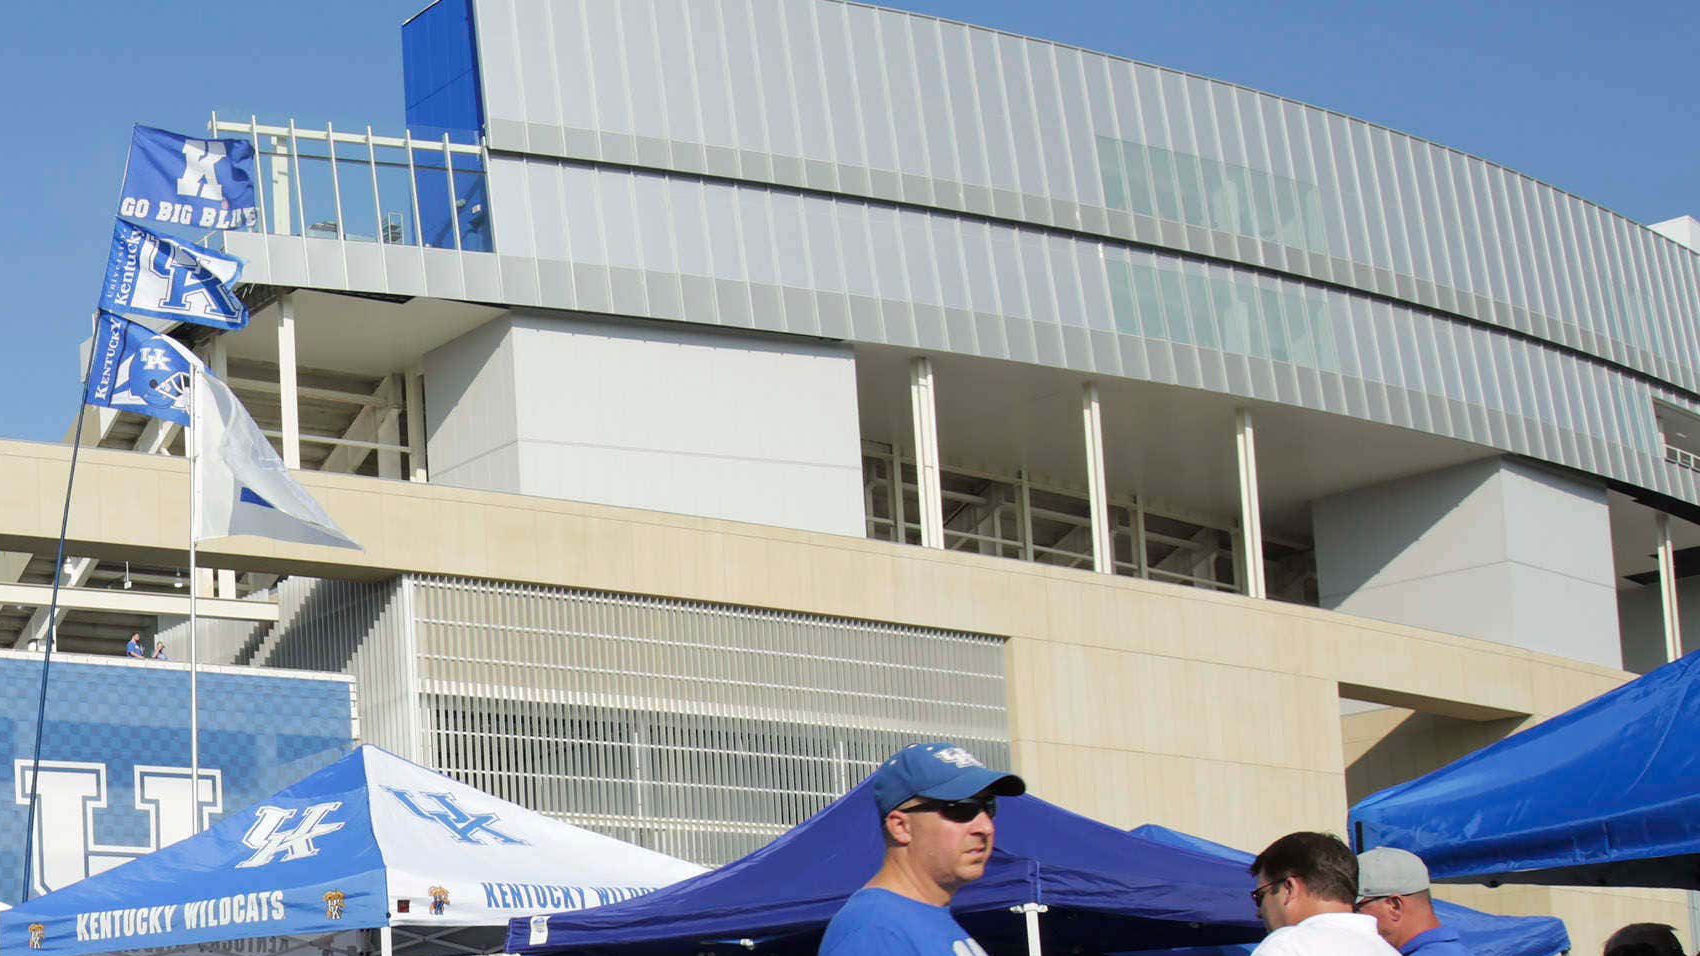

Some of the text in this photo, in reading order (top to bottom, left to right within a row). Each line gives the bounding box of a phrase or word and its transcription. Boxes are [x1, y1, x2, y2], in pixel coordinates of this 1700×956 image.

[119, 196, 150, 219] GO
[155, 200, 193, 226] BIG
[113, 226, 146, 306] Kentucky
[93, 317, 122, 401] KENTUCKY
[76, 889, 285, 942] KENTUCKY WILDCATS
[481, 881, 587, 909] KENTUCKY
